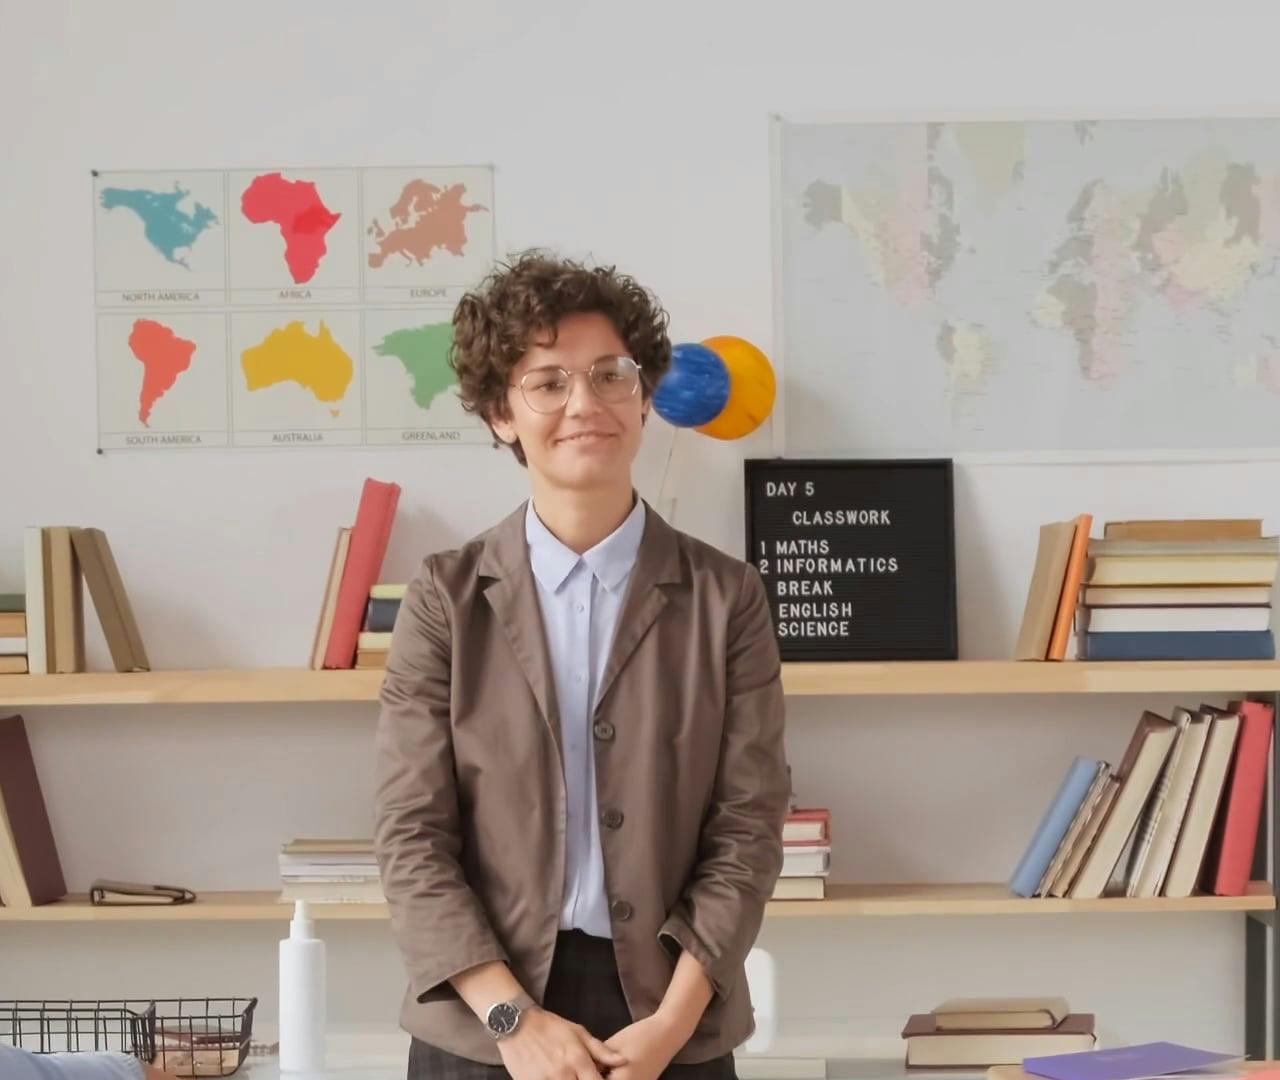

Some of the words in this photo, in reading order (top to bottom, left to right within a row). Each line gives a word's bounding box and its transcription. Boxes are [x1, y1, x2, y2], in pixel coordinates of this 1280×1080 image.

[122, 292, 156, 302] NORTH
[157, 291, 200, 302] AMERICA
[279, 289, 312, 299] AFRICA
[410, 288, 447, 298] EUROPE
[125, 435, 158, 445] SOUTH
[160, 435, 201, 445] AMERICA
[272, 432, 322, 442] AUSTRALIA
[402, 431, 460, 441] GREENLAND
[766, 482, 797, 496] DAY
[805, 481, 815, 496] 5
[792, 510, 891, 525] CLASSWORK
[760, 541, 766, 554] 1
[776, 540, 829, 554] MATHS
[759, 559, 769, 574] 2
[776, 558, 899, 574] INFORMATICS
[777, 581, 833, 596] BREAK
[778, 602, 852, 618] ENGLISH
[778, 621, 849, 637] SCIENCE
